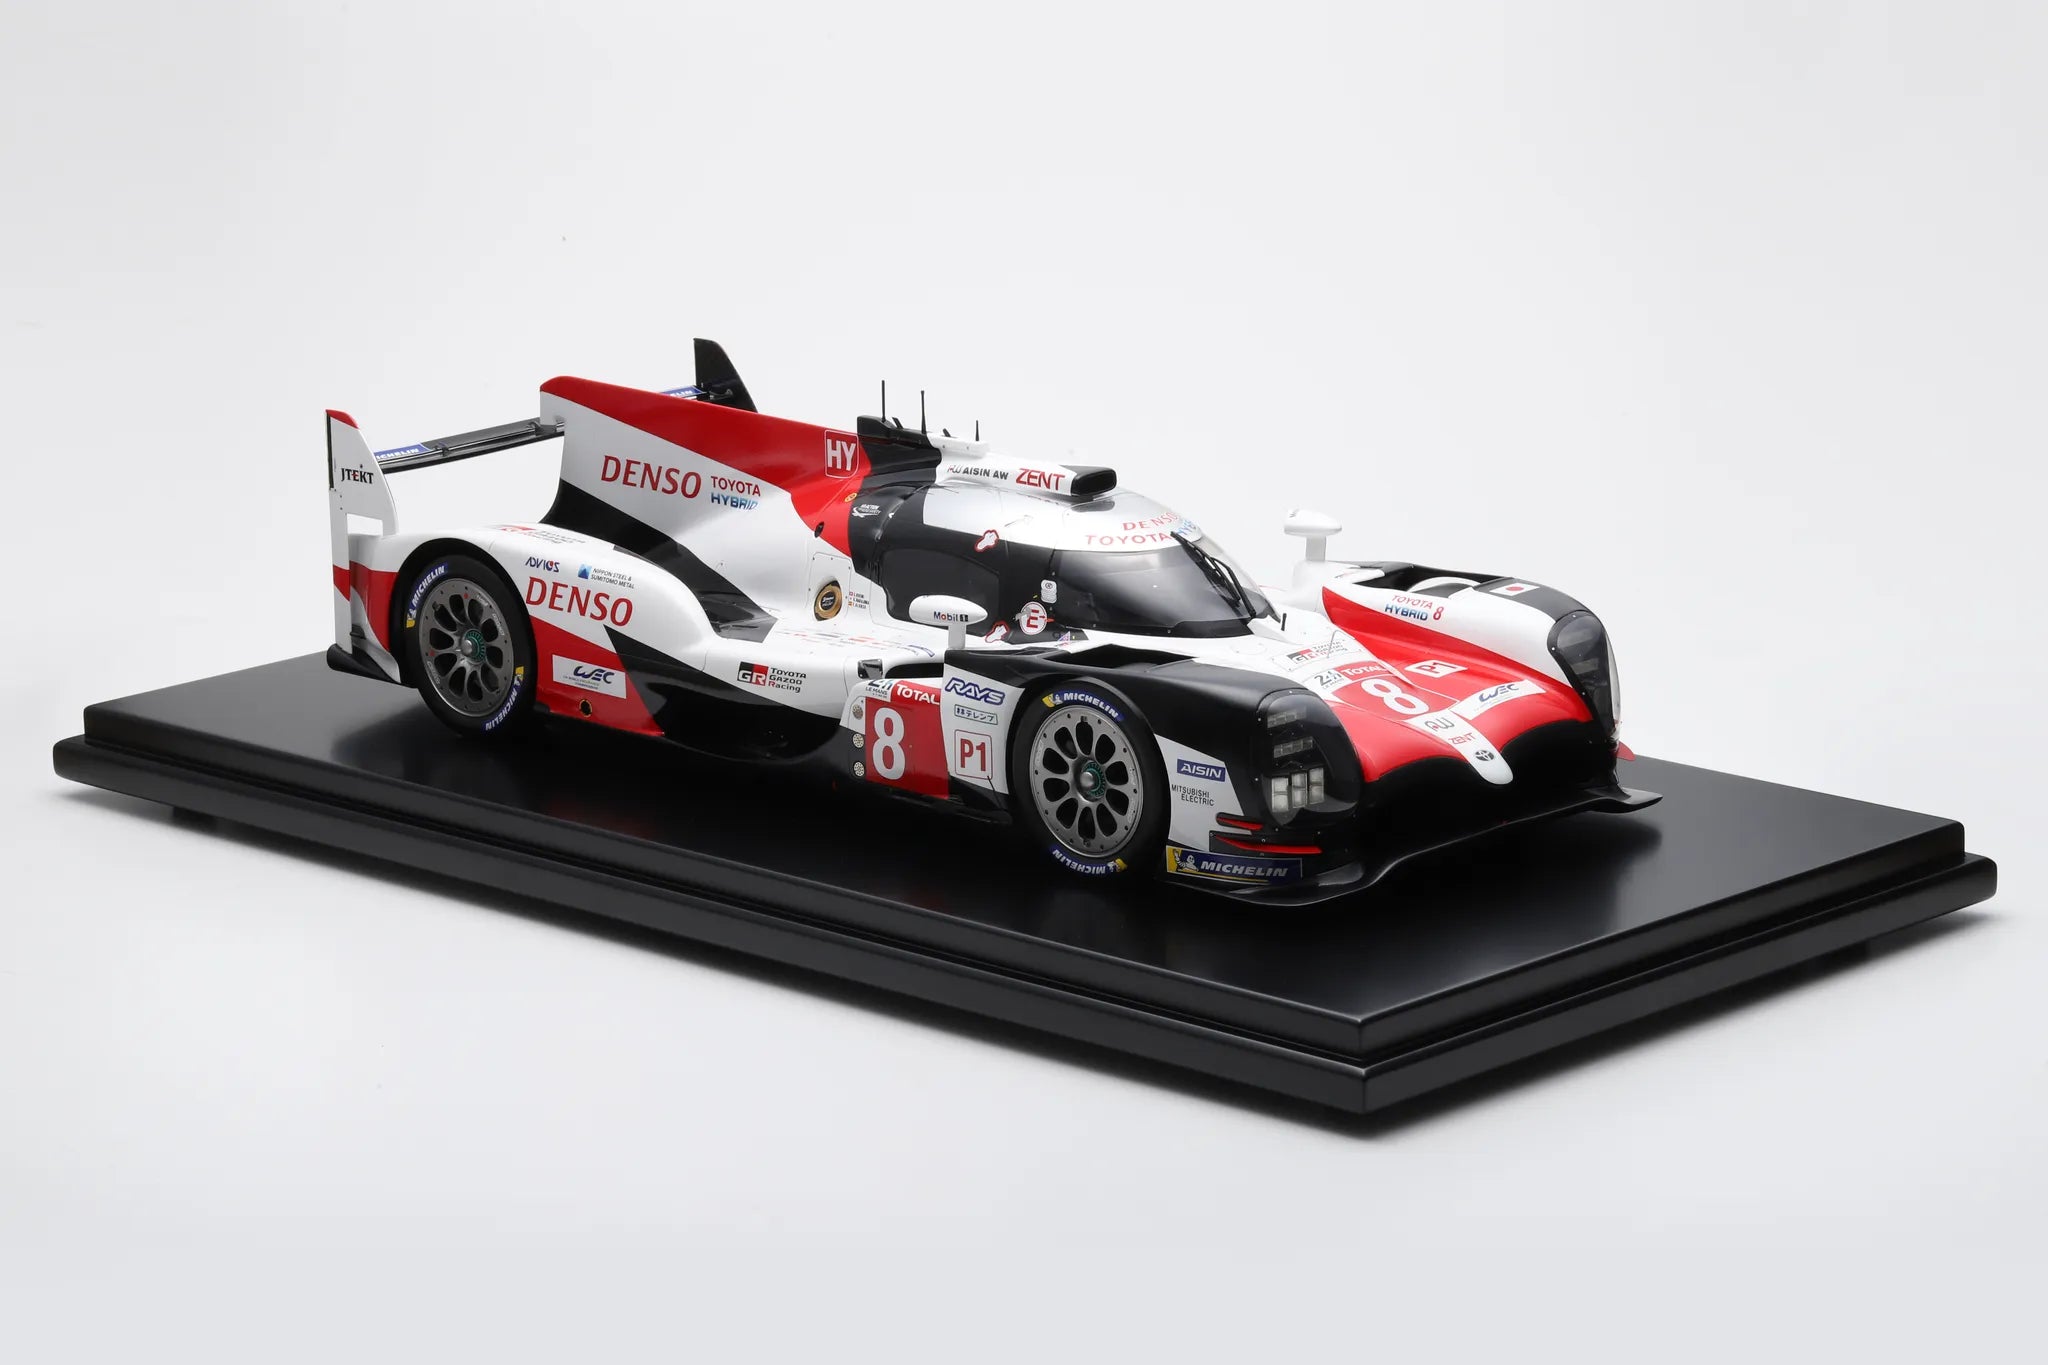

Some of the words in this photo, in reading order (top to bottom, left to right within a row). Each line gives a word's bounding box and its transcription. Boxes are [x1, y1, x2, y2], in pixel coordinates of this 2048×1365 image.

[826, 439, 857, 472] HY
[340, 467, 374, 484] JTEKT
[601, 455, 702, 499] DENSO
[962, 466, 991, 477] AISIN
[992, 471, 1009, 480] AW
[1015, 468, 1066, 491] ZENT
[710, 475, 761, 497] TOYOTA
[710, 492, 759, 511] HYBRID
[1122, 511, 1178, 531] DENSO
[1085, 532, 1173, 546] TOYOTA
[590, 573, 619, 586] SUMITOMO
[618, 579, 635, 589] METAL
[592, 567, 613, 577] NIPPON
[612, 571, 627, 581] STEEL
[412, 565, 446, 606] MICHELIN
[525, 576, 633, 627] DENSO
[1391, 595, 1434, 609] TOYOTA
[933, 611, 958, 622] Mobil
[1026, 609, 1040, 628] E
[1384, 603, 1428, 621] HYBRID
[1432, 606, 1445, 621] 8
[573, 665, 615, 684] WEC
[770, 667, 807, 679] TOYOTA
[1340, 665, 1388, 677] TOTAL
[1415, 661, 1458, 674] P1
[738, 669, 766, 686] GR
[769, 674, 803, 685] GAZOO
[768, 681, 801, 693] Racing
[896, 683, 941, 706] TOTAL
[945, 677, 1006, 706] RAYS
[1478, 684, 1519, 702] WEC
[1063, 692, 1119, 718] MICHELIN
[1361, 678, 1430, 715] 8
[486, 688, 519, 731] MICHELIN
[872, 707, 906, 780] 8
[1448, 732, 1476, 745] ZENT
[960, 738, 986, 772] P1
[1180, 763, 1222, 778] AISIN
[1171, 784, 1210, 798] MITSUBISHI
[1181, 793, 1215, 807] ELECTRIC
[1052, 849, 1106, 874] MICHELIN
[1200, 861, 1288, 877] MICHELIN
